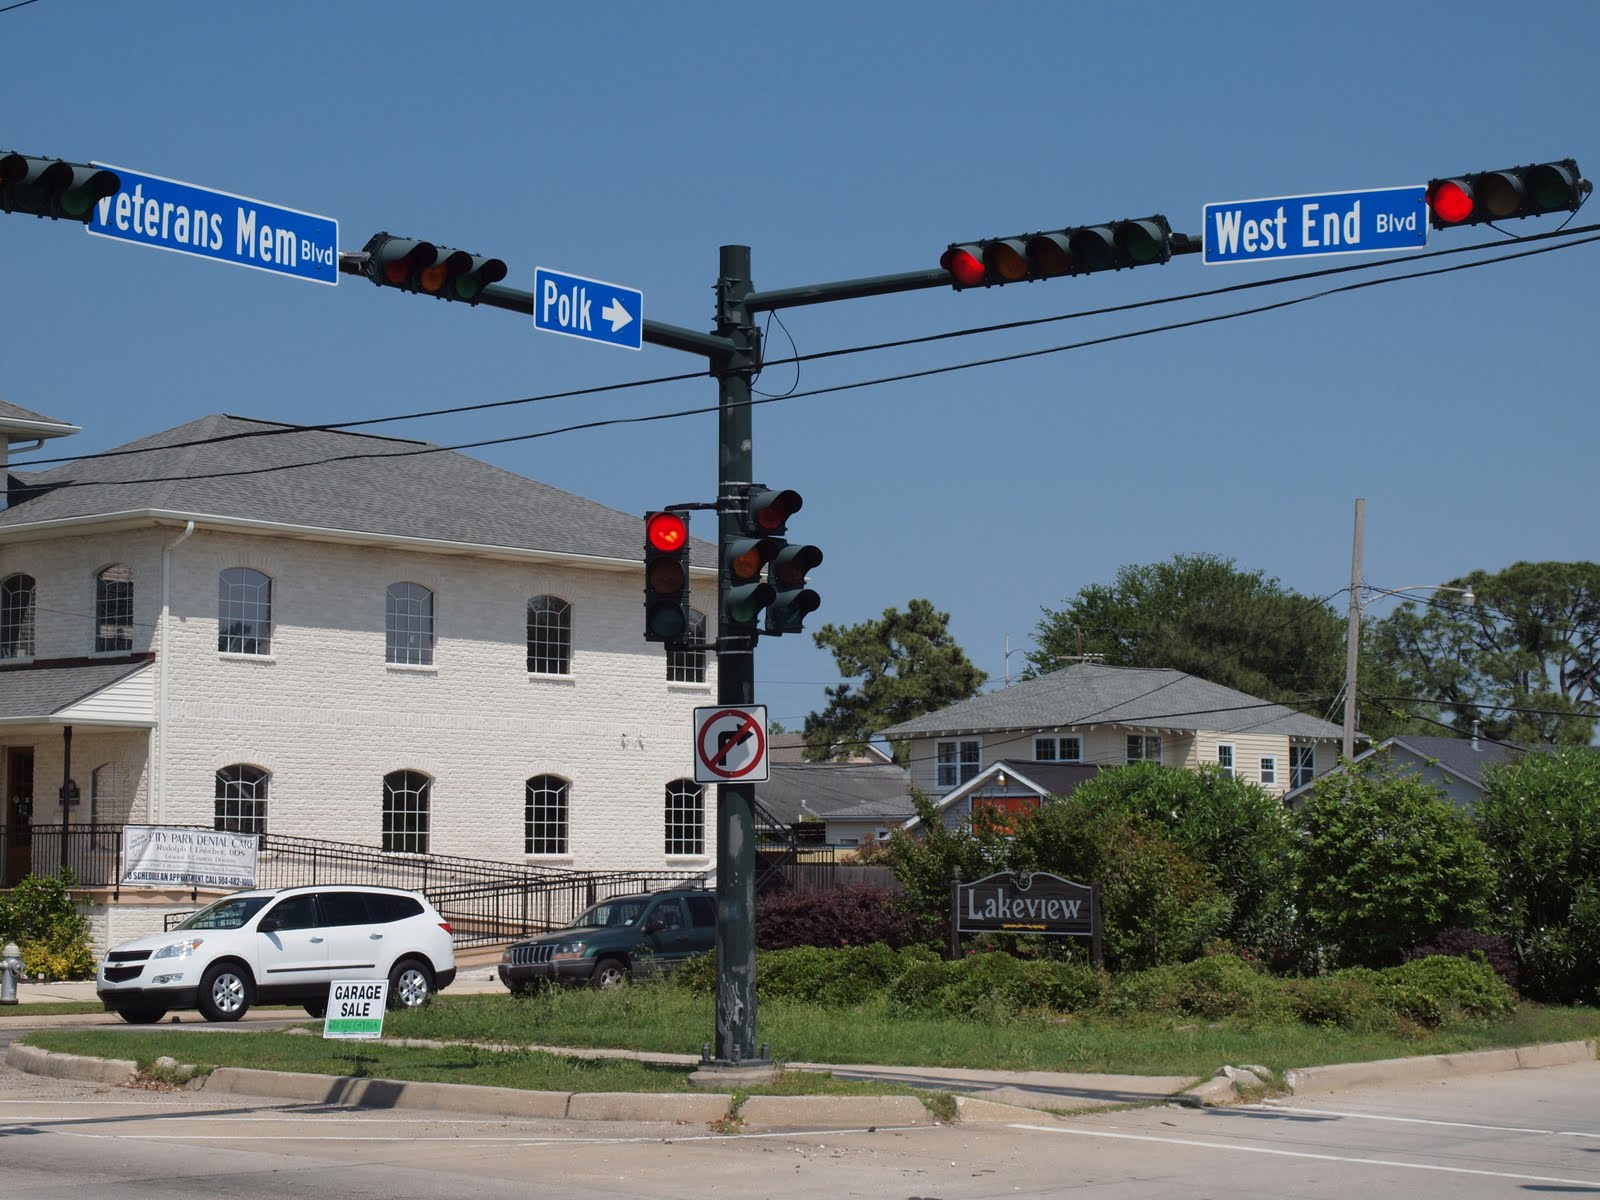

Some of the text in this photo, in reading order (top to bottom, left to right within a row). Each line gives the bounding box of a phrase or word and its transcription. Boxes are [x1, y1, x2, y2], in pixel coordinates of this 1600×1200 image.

[98, 184, 333, 267] Veterans Mem Blvd
[1215, 200, 1416, 254] West End Blvd
[543, 279, 592, 331] Polk
[149, 832, 168, 843] CITY
[171, 833, 194, 844] PARK
[197, 835, 229, 848] DENTAL
[231, 837, 255, 850] CARE
[229, 849, 246, 857] DDS
[133, 872, 160, 881] SCHEDULE
[160, 872, 168, 881] AN
[205, 875, 217, 884] CALL
[968, 888, 1082, 921] Lakeview
[335, 985, 382, 1000] GARAGE
[341, 1002, 370, 1017] SALE
